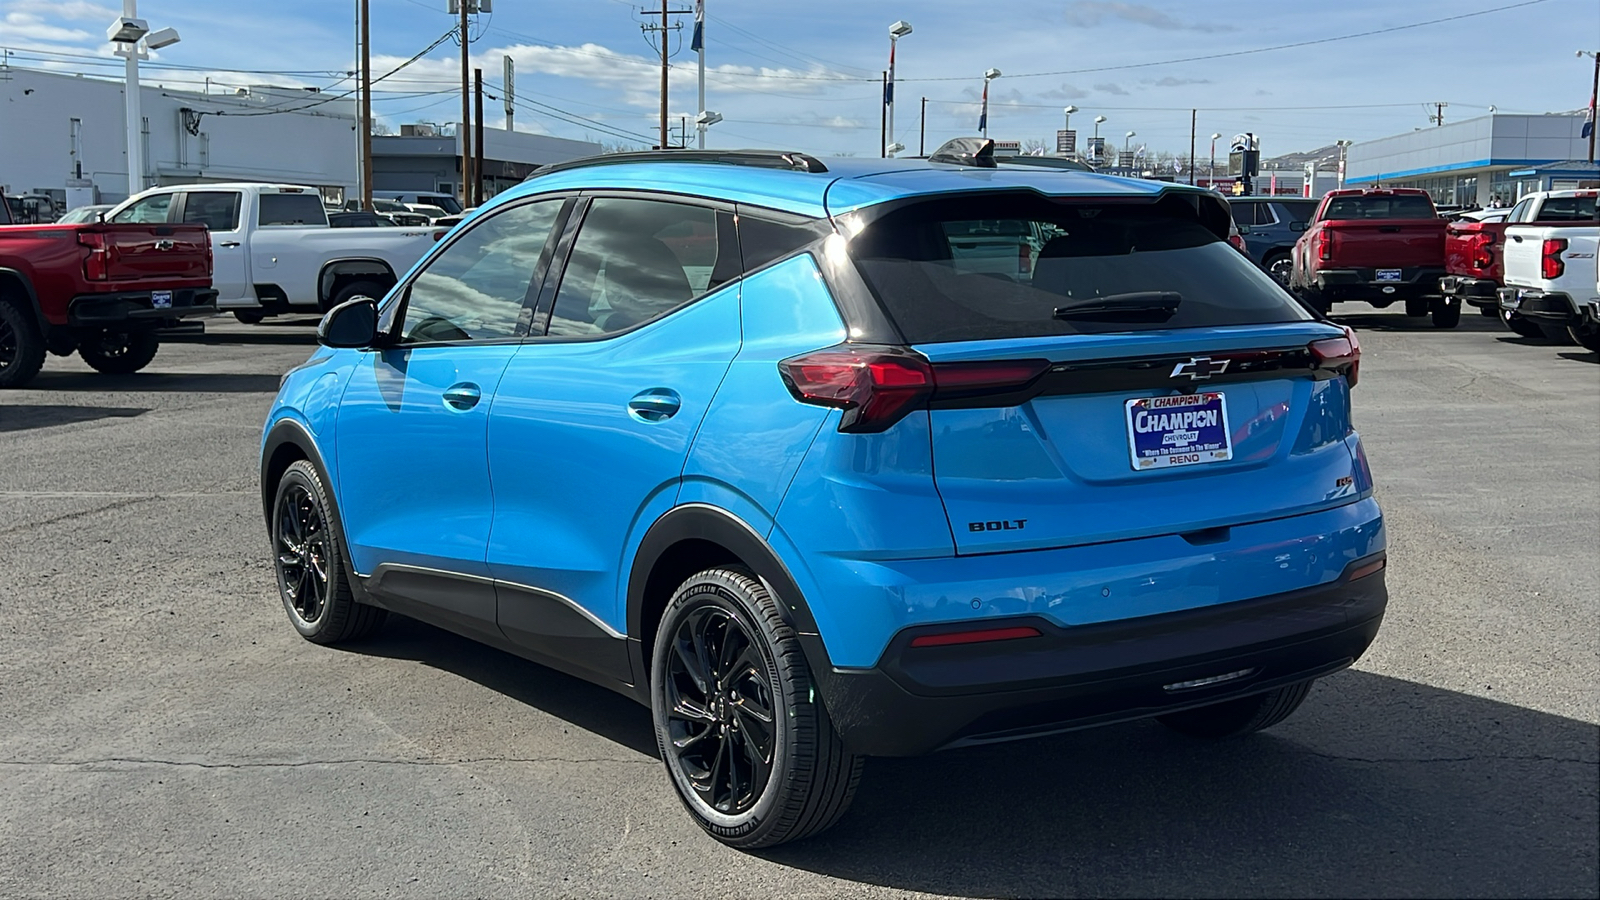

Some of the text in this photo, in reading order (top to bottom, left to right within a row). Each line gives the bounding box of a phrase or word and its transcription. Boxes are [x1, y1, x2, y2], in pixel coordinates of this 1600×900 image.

[1154, 395, 1200, 408] CHAMPION
[1135, 409, 1218, 433] CHAMPION
[1164, 432, 1197, 443] CHEVROLET
[1169, 454, 1200, 465] RENO
[968, 519, 1028, 533] BOLT
[681, 585, 717, 600] MICHELIN
[712, 825, 750, 836] MICHELIN
